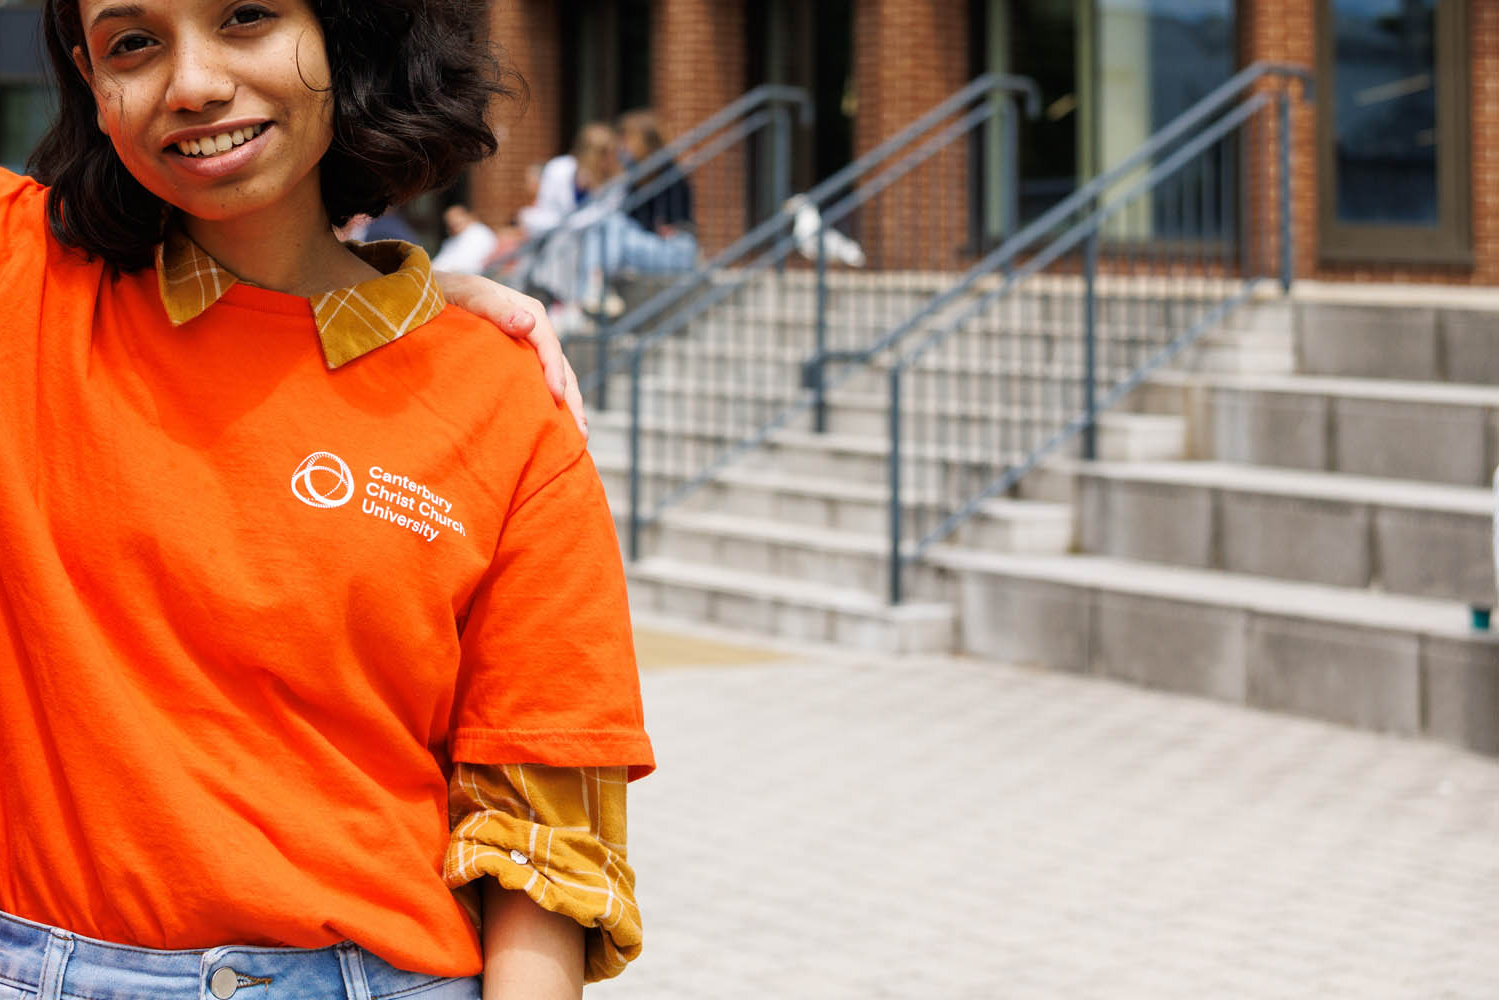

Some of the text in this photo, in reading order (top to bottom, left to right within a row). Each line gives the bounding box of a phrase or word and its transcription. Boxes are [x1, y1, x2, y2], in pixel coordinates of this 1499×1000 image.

[366, 482, 466, 537] Christ Church
[369, 466, 453, 513] Canterbury
[361, 498, 440, 542] University
